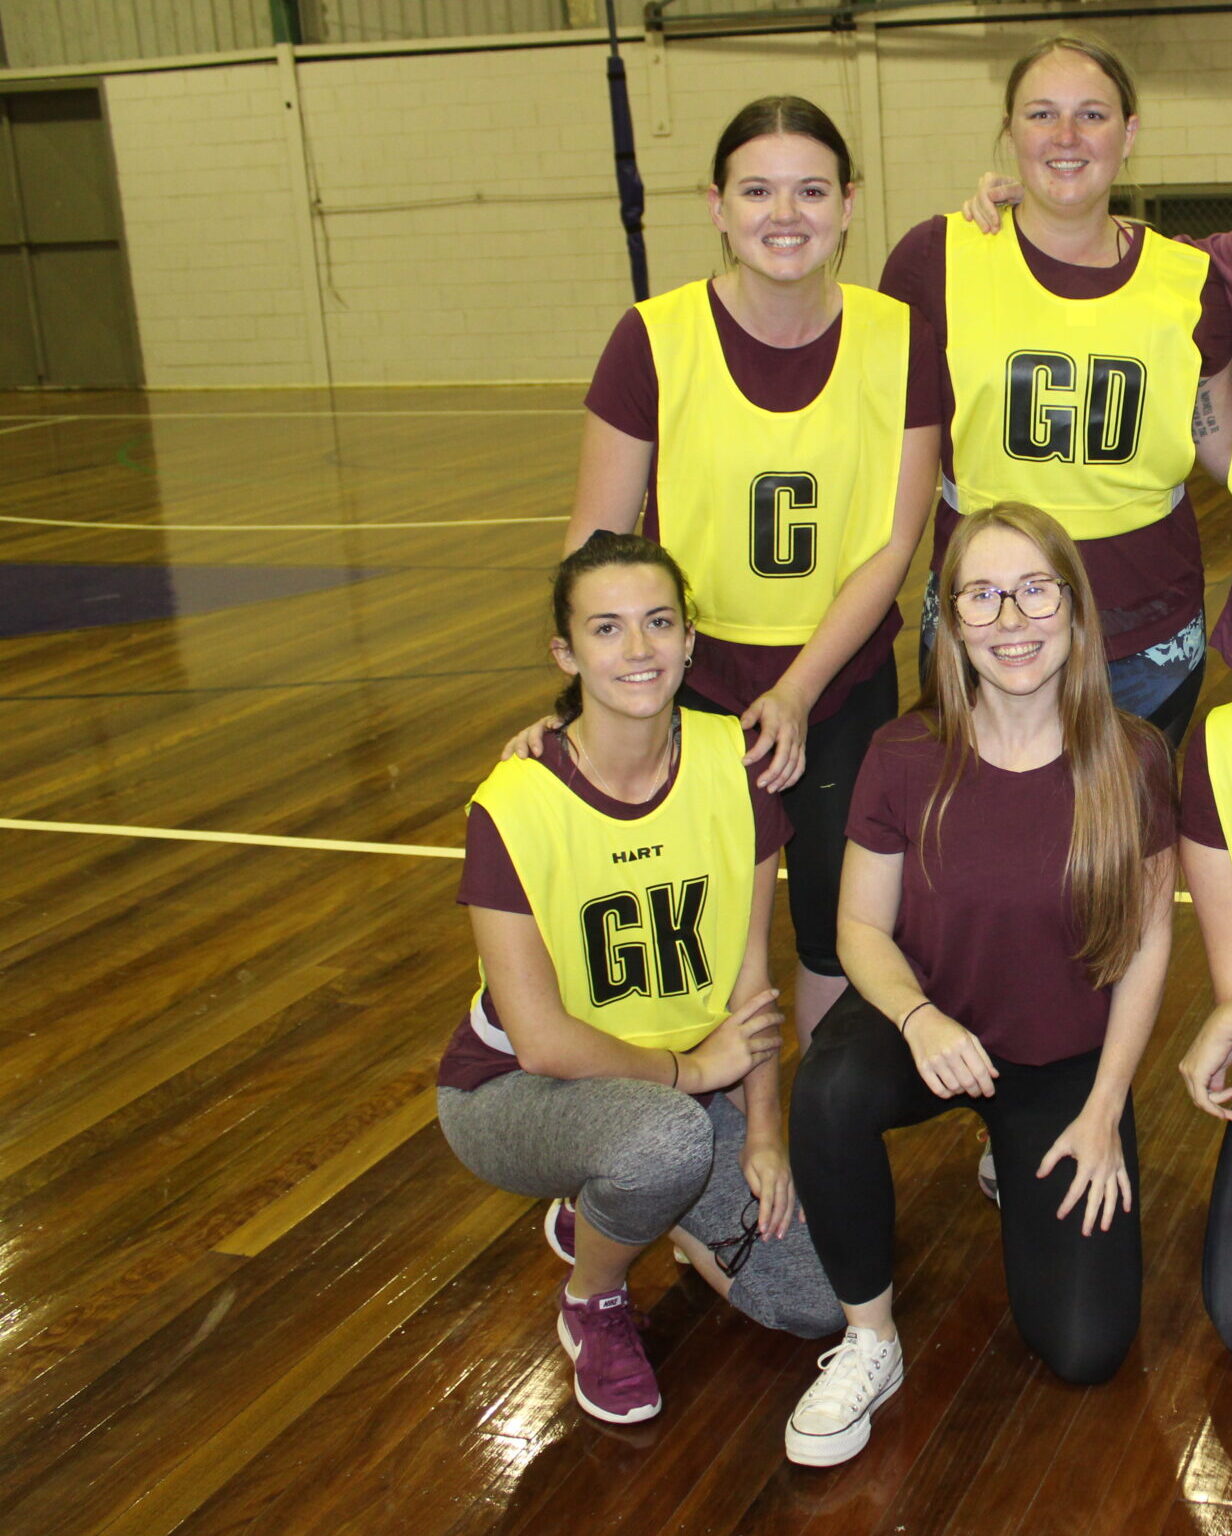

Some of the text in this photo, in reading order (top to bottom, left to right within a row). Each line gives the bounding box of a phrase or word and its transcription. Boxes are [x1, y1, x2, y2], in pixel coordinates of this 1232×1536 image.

[1003, 349, 1147, 464] GD
[749, 471, 818, 578] C
[612, 844, 664, 864] HART
[580, 874, 713, 1007] GK
